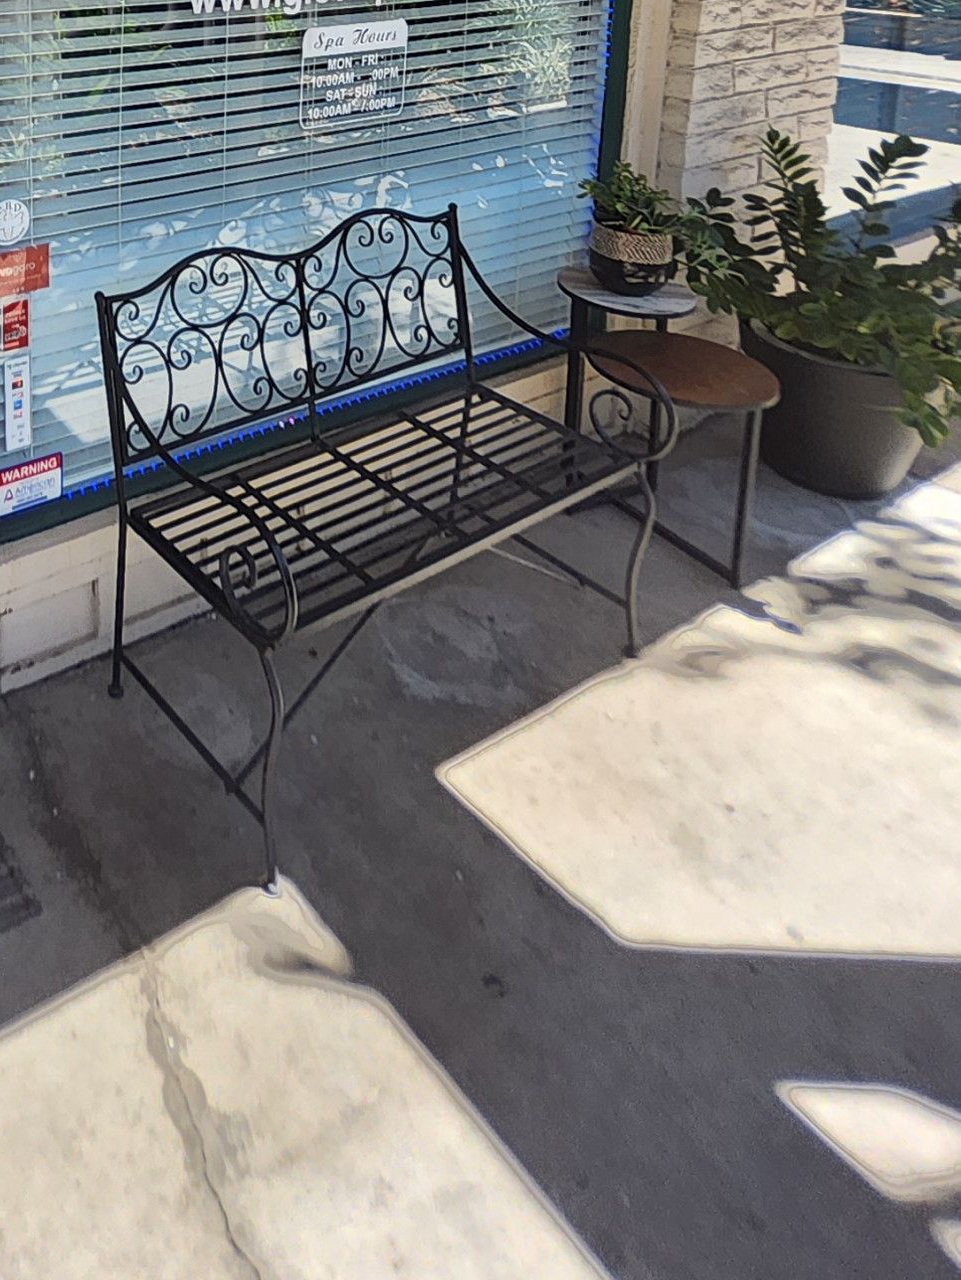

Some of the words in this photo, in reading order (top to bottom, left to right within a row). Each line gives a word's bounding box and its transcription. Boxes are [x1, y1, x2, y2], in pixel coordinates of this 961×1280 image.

[313, 31, 344, 52] Spa
[353, 28, 397, 46] Hours
[327, 57, 353, 71] MON
[312, 72, 354, 88] 10:00AM
[326, 87, 347, 102] SAT
[307, 103, 351, 119] 10:00AM
[1, 457, 58, 484] WARNING
